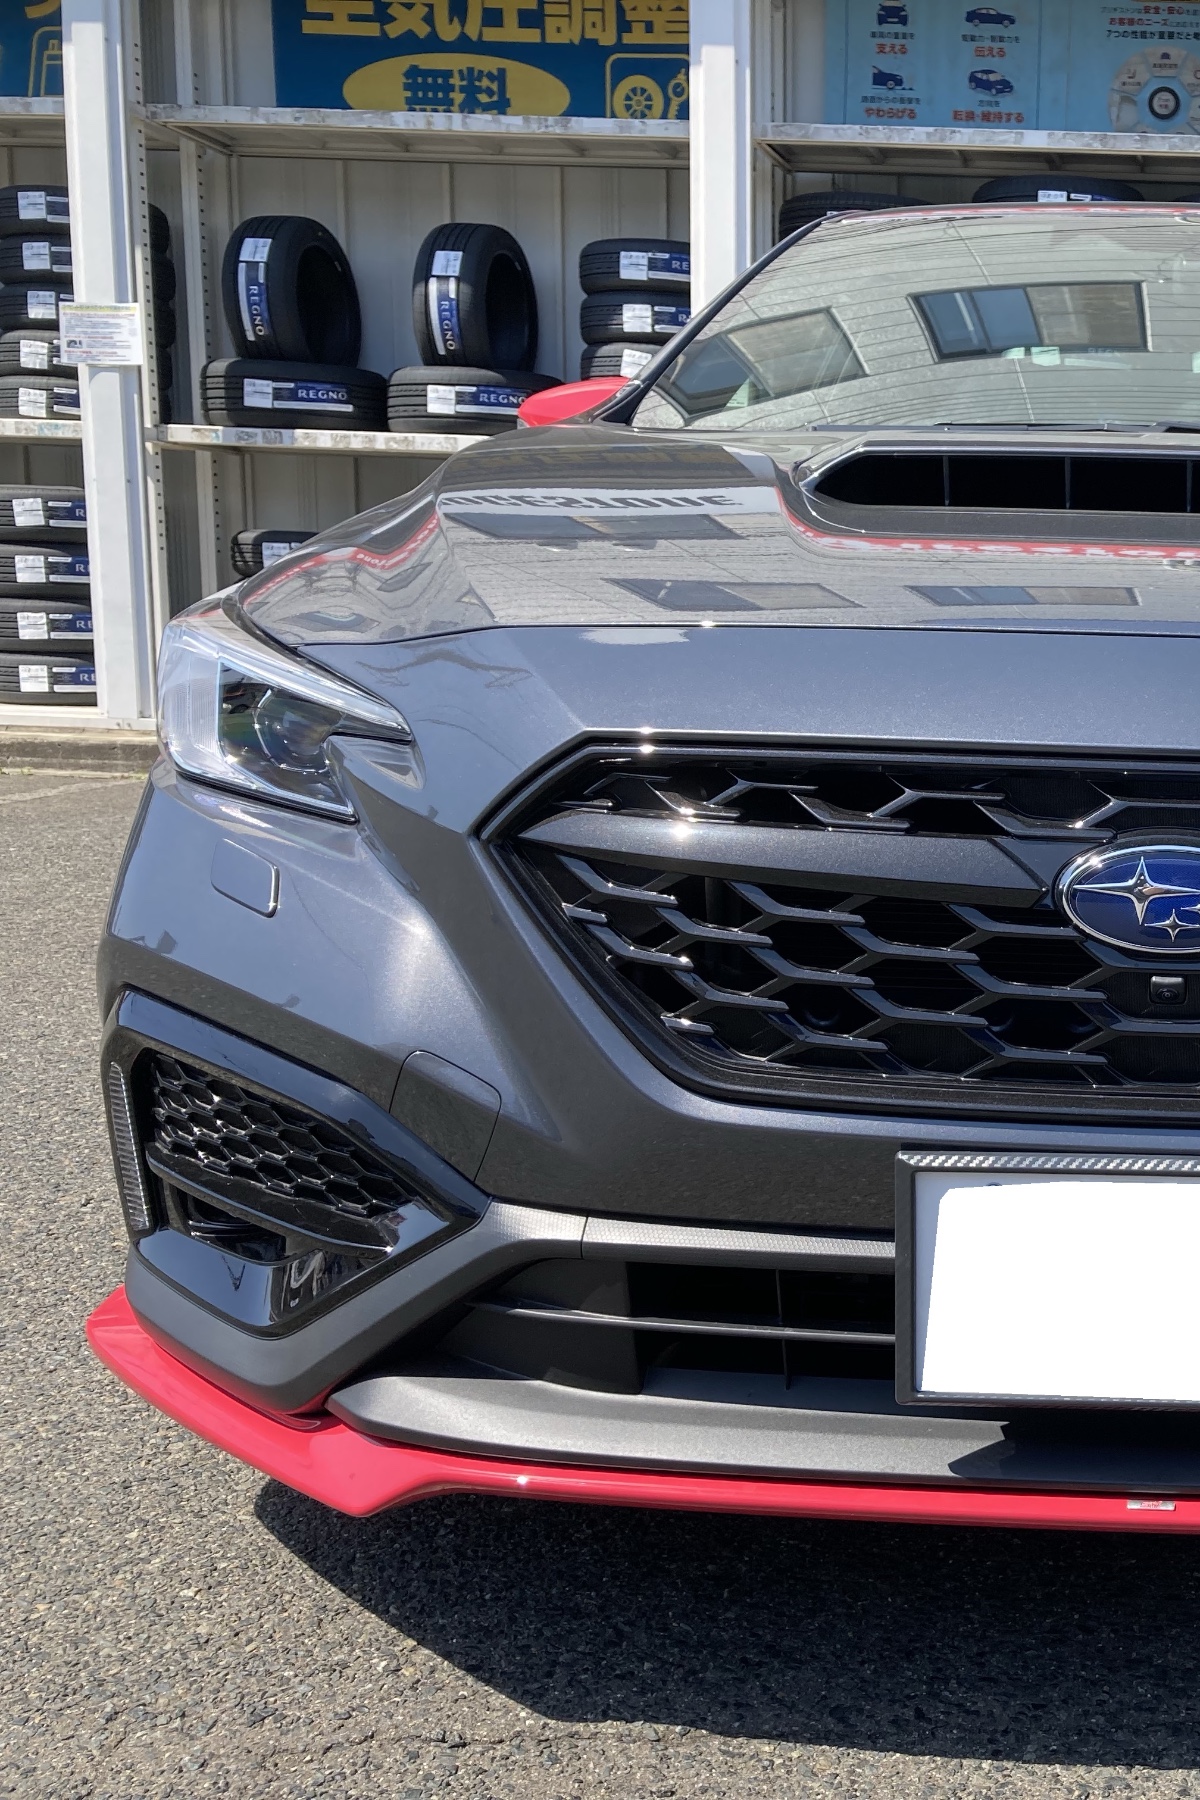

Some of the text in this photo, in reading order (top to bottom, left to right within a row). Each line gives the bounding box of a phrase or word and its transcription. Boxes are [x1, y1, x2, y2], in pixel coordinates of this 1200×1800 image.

[875, 43, 908, 55] 支える
[973, 46, 1007, 58] 伝える
[402, 64, 510, 114] 無料
[249, 285, 266, 337] REGNO
[440, 300, 456, 350] REGNO
[297, 388, 348, 401] REGNO
